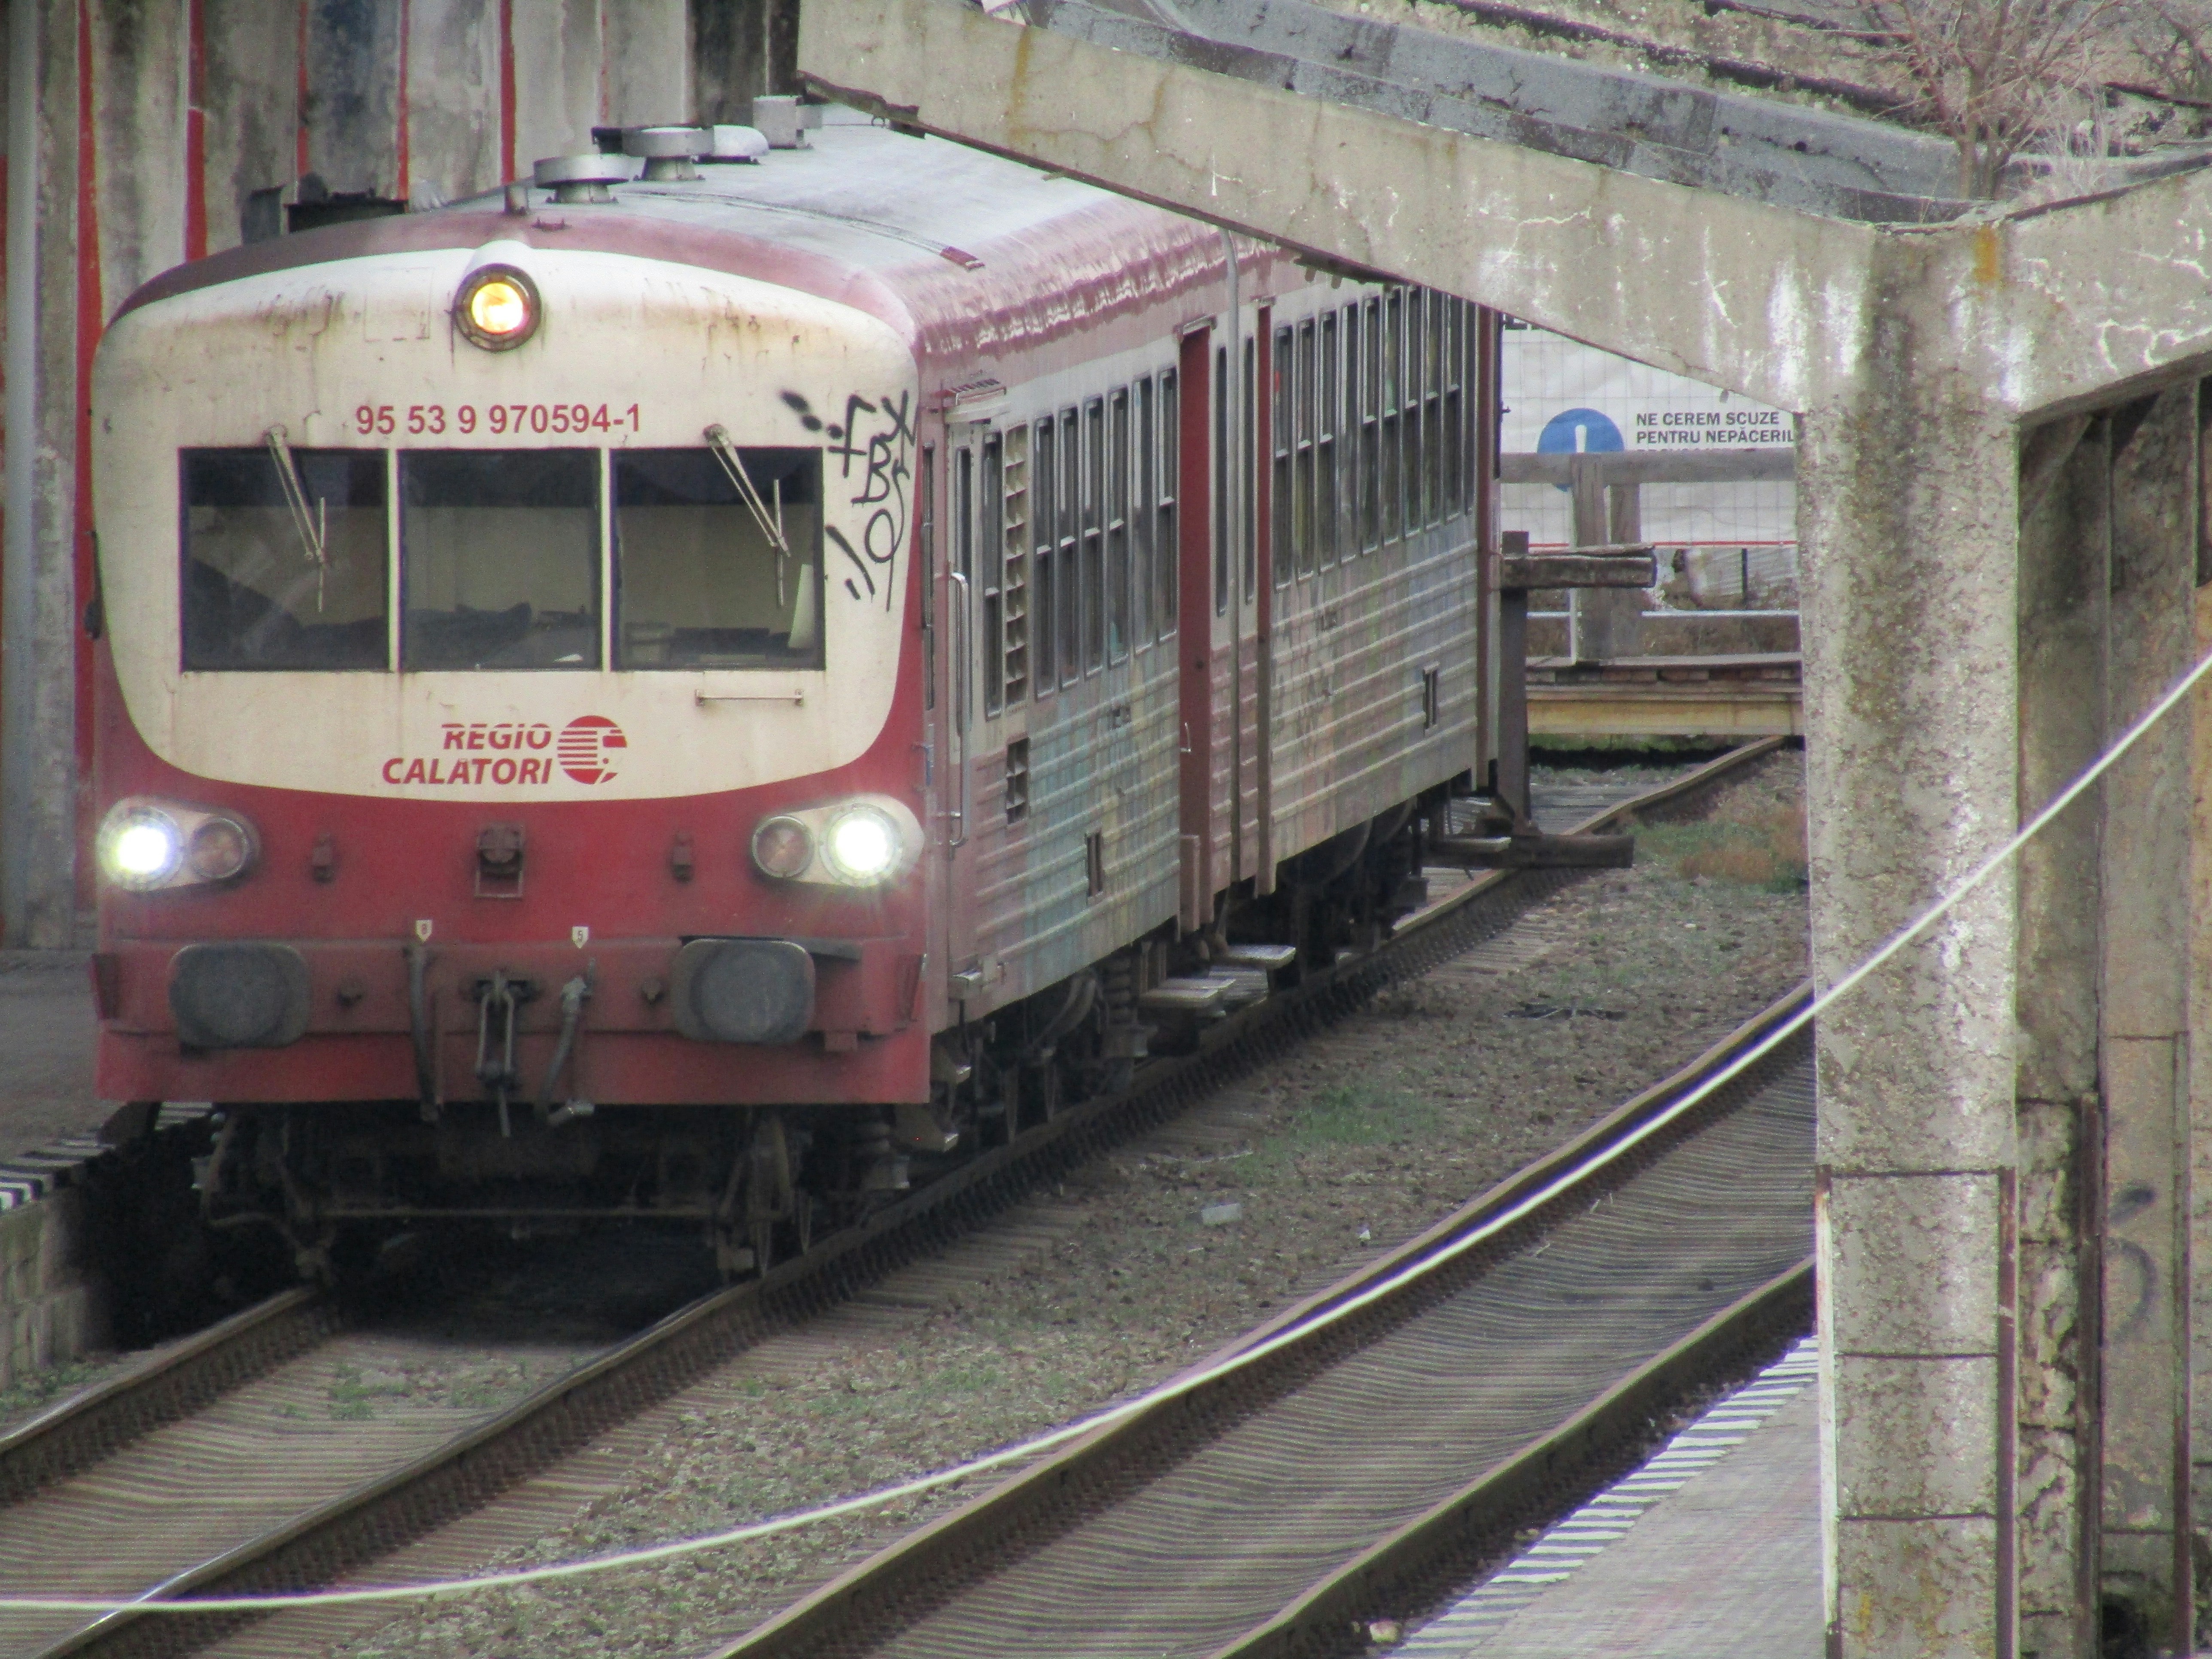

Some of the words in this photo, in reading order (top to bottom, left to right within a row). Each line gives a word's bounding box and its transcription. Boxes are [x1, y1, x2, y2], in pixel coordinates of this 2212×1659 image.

[356, 405, 395, 434] 95
[408, 405, 446, 434] 53
[458, 405, 477, 434] 9
[489, 403, 640, 434] 970594-1
[1637, 412, 1658, 426] NE
[1662, 412, 1720, 425] CEREM
[1726, 411, 1780, 425] SCUZE
[1637, 430, 1700, 444] PENTRU
[1706, 426, 1794, 443] NEPĂCERIL
[441, 723, 552, 750] REGIO
